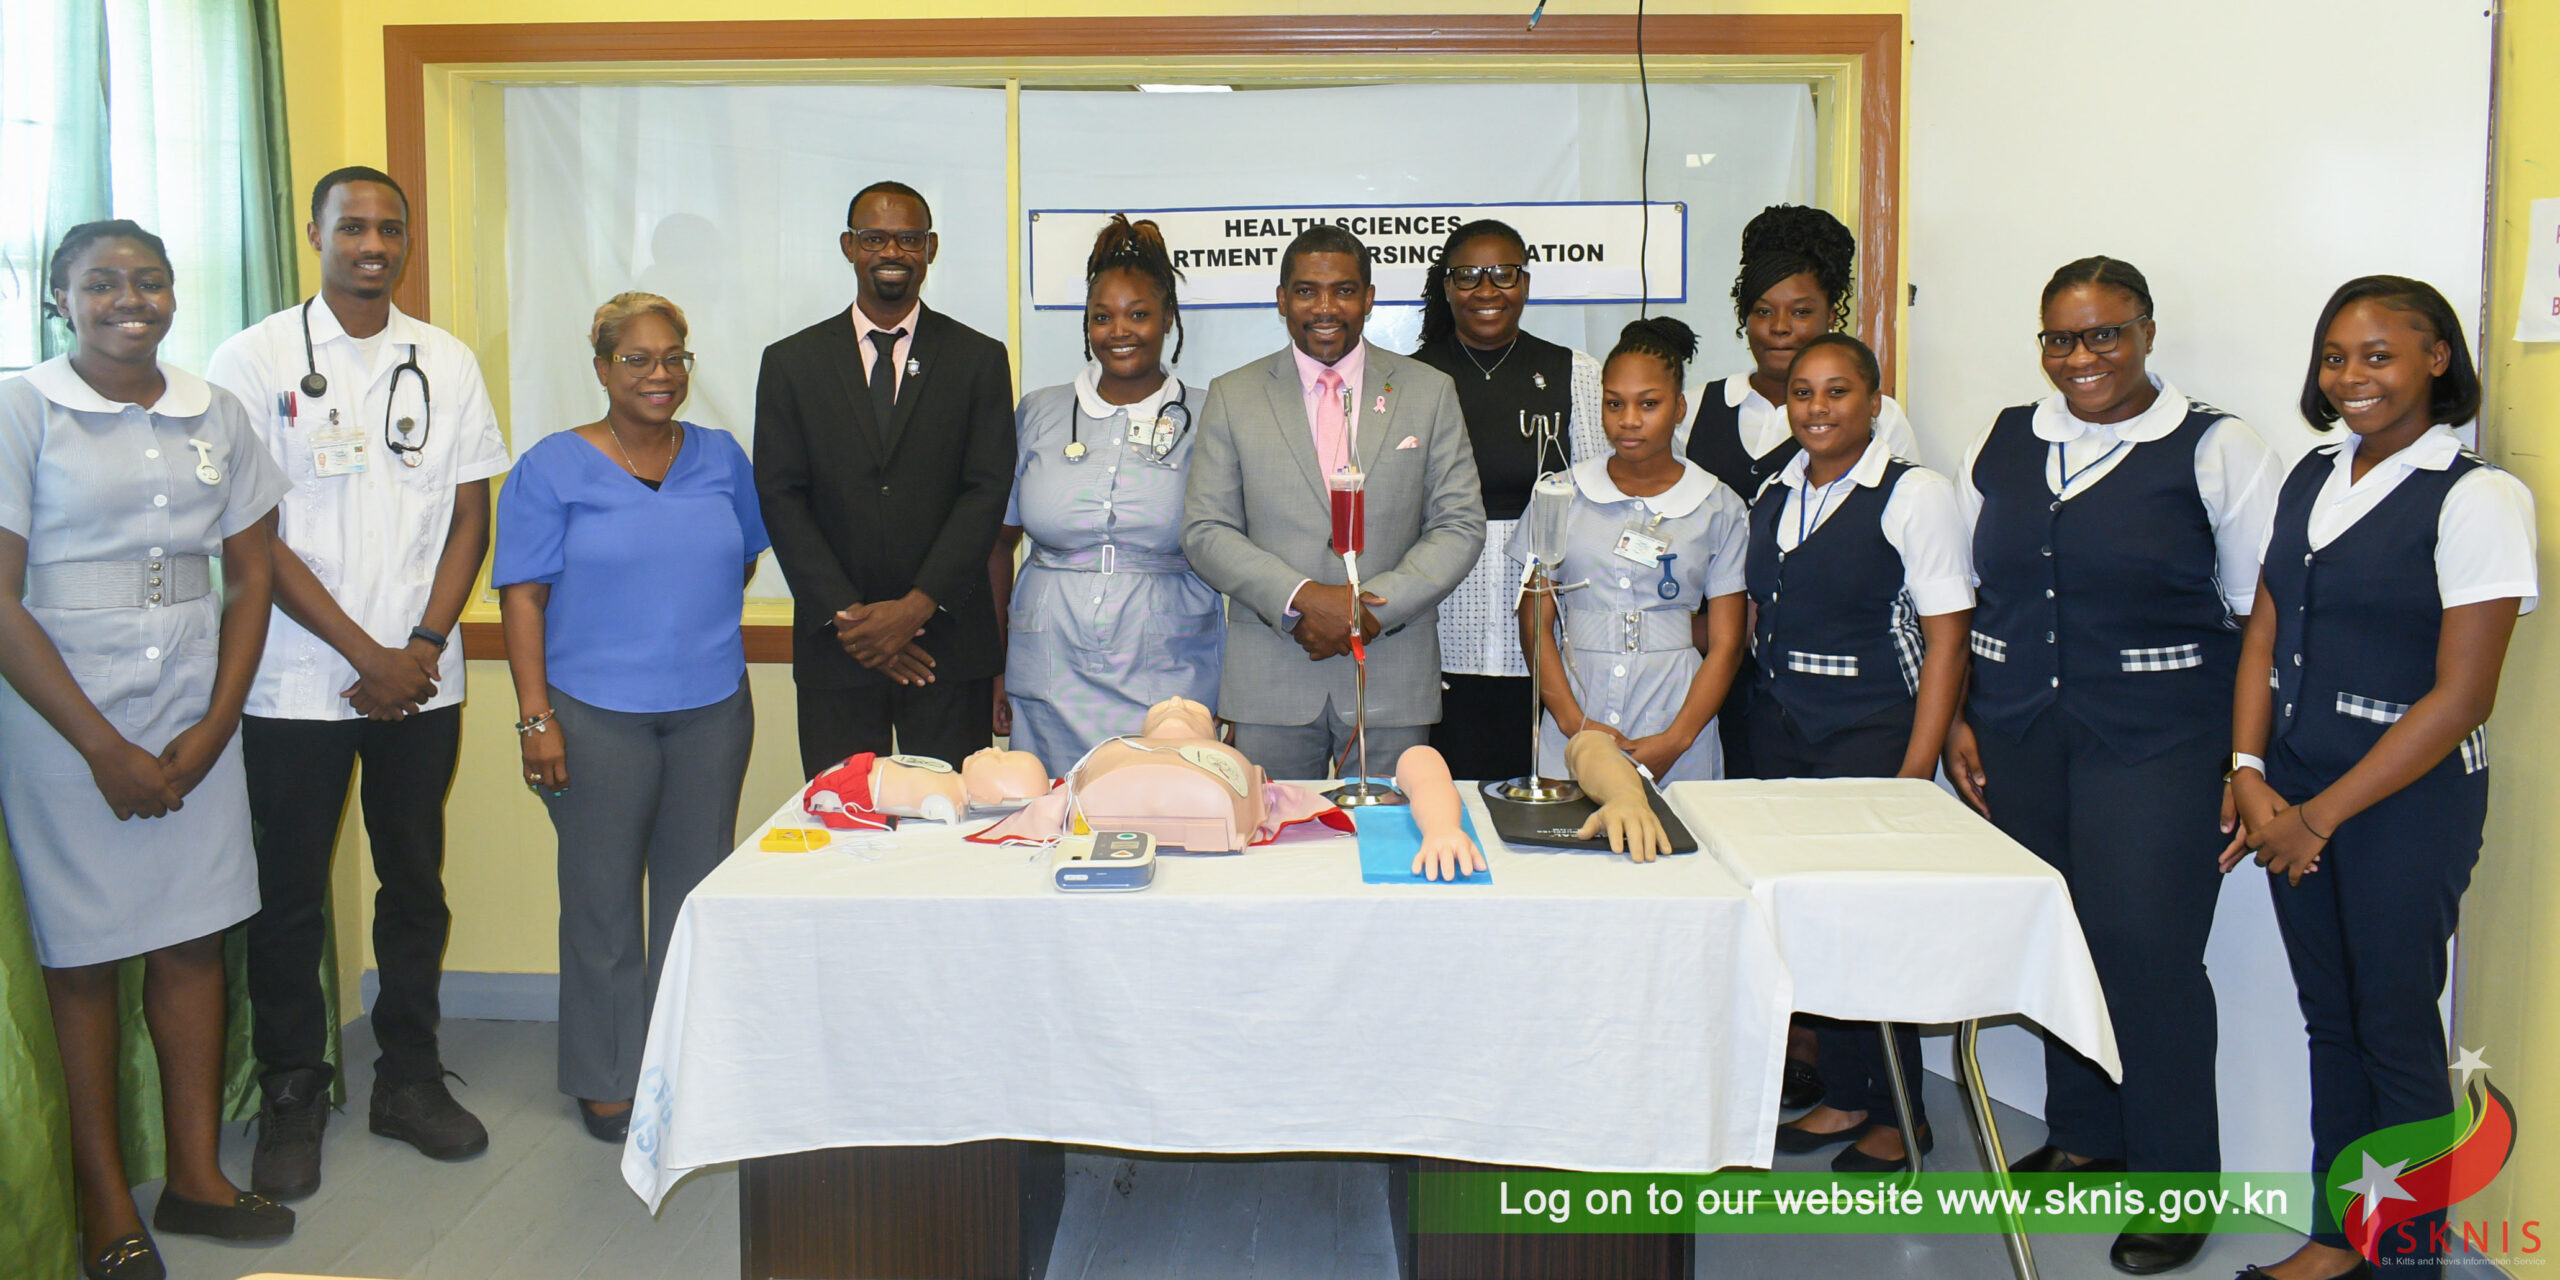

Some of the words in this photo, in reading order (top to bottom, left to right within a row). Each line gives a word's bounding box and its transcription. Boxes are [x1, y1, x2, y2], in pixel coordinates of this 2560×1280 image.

[1335, 216, 1461, 235] SCIENCES
[1173, 248, 1278, 267] RTMENT
[1367, 245, 1444, 264] RSING
[1526, 244, 1604, 262] ATION
